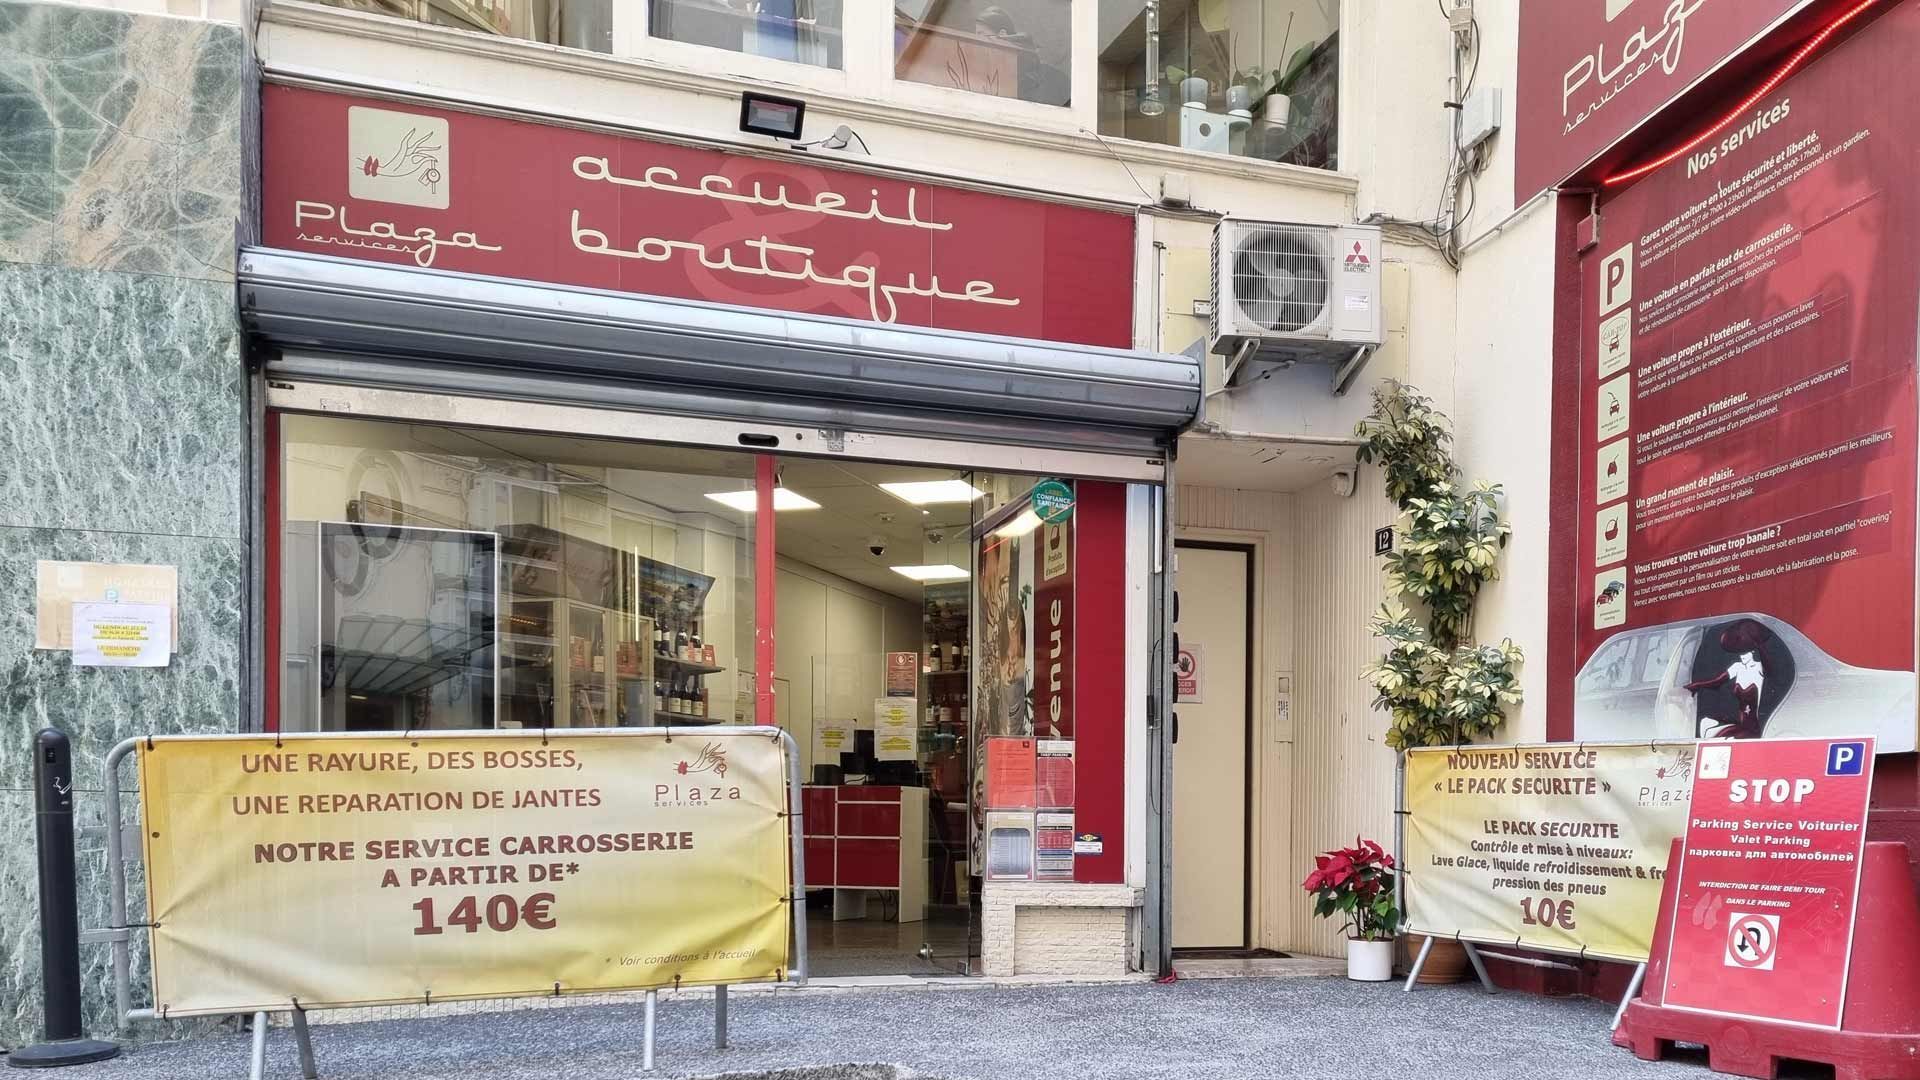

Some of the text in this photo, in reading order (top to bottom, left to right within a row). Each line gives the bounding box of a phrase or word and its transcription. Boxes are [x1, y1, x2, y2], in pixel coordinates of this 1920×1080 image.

[1563, 0, 1703, 117] Plaz
[1563, 51, 1664, 136] services
[1687, 98, 1791, 179] Nos services
[1793, 153, 1825, 180] personnel
[1842, 129, 1871, 151] gardien.
[573, 156, 953, 231] accueil
[1640, 130, 1819, 246] Garez votre voiture en toute sécurité et liberté.
[296, 200, 502, 268] Plaza
[296, 232, 417, 254] services
[571, 209, 1021, 324] boutique
[1639, 222, 1794, 312] Une voiture en parfait état de carrosserie.
[1606, 256, 1625, 306] P
[1773, 308, 1799, 327] pouvons
[1800, 300, 1815, 313] laver
[1773, 327, 1784, 337] des
[1638, 317, 1752, 378] Une voiture propre à l'extérieur.
[1810, 370, 1832, 385] voiture
[1833, 364, 1849, 377] avec
[1636, 391, 1749, 444] Une voiture propre à l'intérieur.
[1828, 443, 1848, 458] parmi
[1848, 440, 1859, 450] les
[1636, 467, 1735, 509] Un grand moment de plaisir.
[1378, 530, 1390, 551] 12
[1755, 542, 1775, 554] voiture
[1788, 537, 1796, 546] en
[1797, 532, 1812, 544] total
[1812, 529, 1824, 539] soit
[1824, 528, 1834, 536] en
[1834, 520, 1856, 536] partiel
[1634, 525, 1781, 575] Vous trouvez votre voiture trop banale ?
[1776, 565, 1785, 574] de
[1785, 562, 1791, 571] la
[1791, 555, 1825, 570] fabrication
[1825, 554, 1833, 562] et
[1833, 551, 1840, 560] la
[241, 749, 583, 774] UNE RAYURE, DES BOSSES,
[1447, 751, 1597, 770] NOUVEAU SERVICE
[1835, 747, 1854, 771] P
[655, 783, 741, 801] Plaza
[1448, 777, 1464, 794] LE
[1468, 777, 1507, 794] PACK
[1511, 777, 1596, 795] SECURITE
[1729, 778, 1815, 803] STOP
[232, 788, 601, 815] UNE REPARATION DE JANTES
[1484, 820, 1619, 839] LE PACK SECURITE
[1692, 819, 1859, 831] Parking Service Voiturier
[254, 832, 694, 863] NOTRE SERVICE CARROSSERIE
[1471, 839, 1633, 859] Contrôle et mise à niveaux:
[1731, 835, 1811, 848] Valet Parking
[1432, 854, 1453, 867] Lave
[1457, 856, 1490, 871] Glace,
[1493, 858, 1530, 873] liquide
[1533, 861, 1632, 878] refroidissement
[1636, 866, 1646, 880] &
[1689, 849, 1854, 862] парковка для автомобилей
[381, 869, 400, 888] A
[410, 864, 519, 887] PARTIR
[1492, 876, 1607, 896] pression des pneus
[1699, 881, 1748, 890] INTERDICTION
[1760, 884, 1782, 892] FAIRE
[1783, 885, 1803, 893] DEMI
[1804, 886, 1826, 894] TOUR
[412, 892, 557, 936] 140€
[1520, 896, 1576, 930] 10€
[1726, 897, 1745, 905] DANS
[1757, 899, 1791, 908] PARKING
[619, 956, 642, 966] Voir
[644, 951, 699, 965] conditions
[703, 950, 710, 960] à
[712, 949, 756, 960] l'accueil
